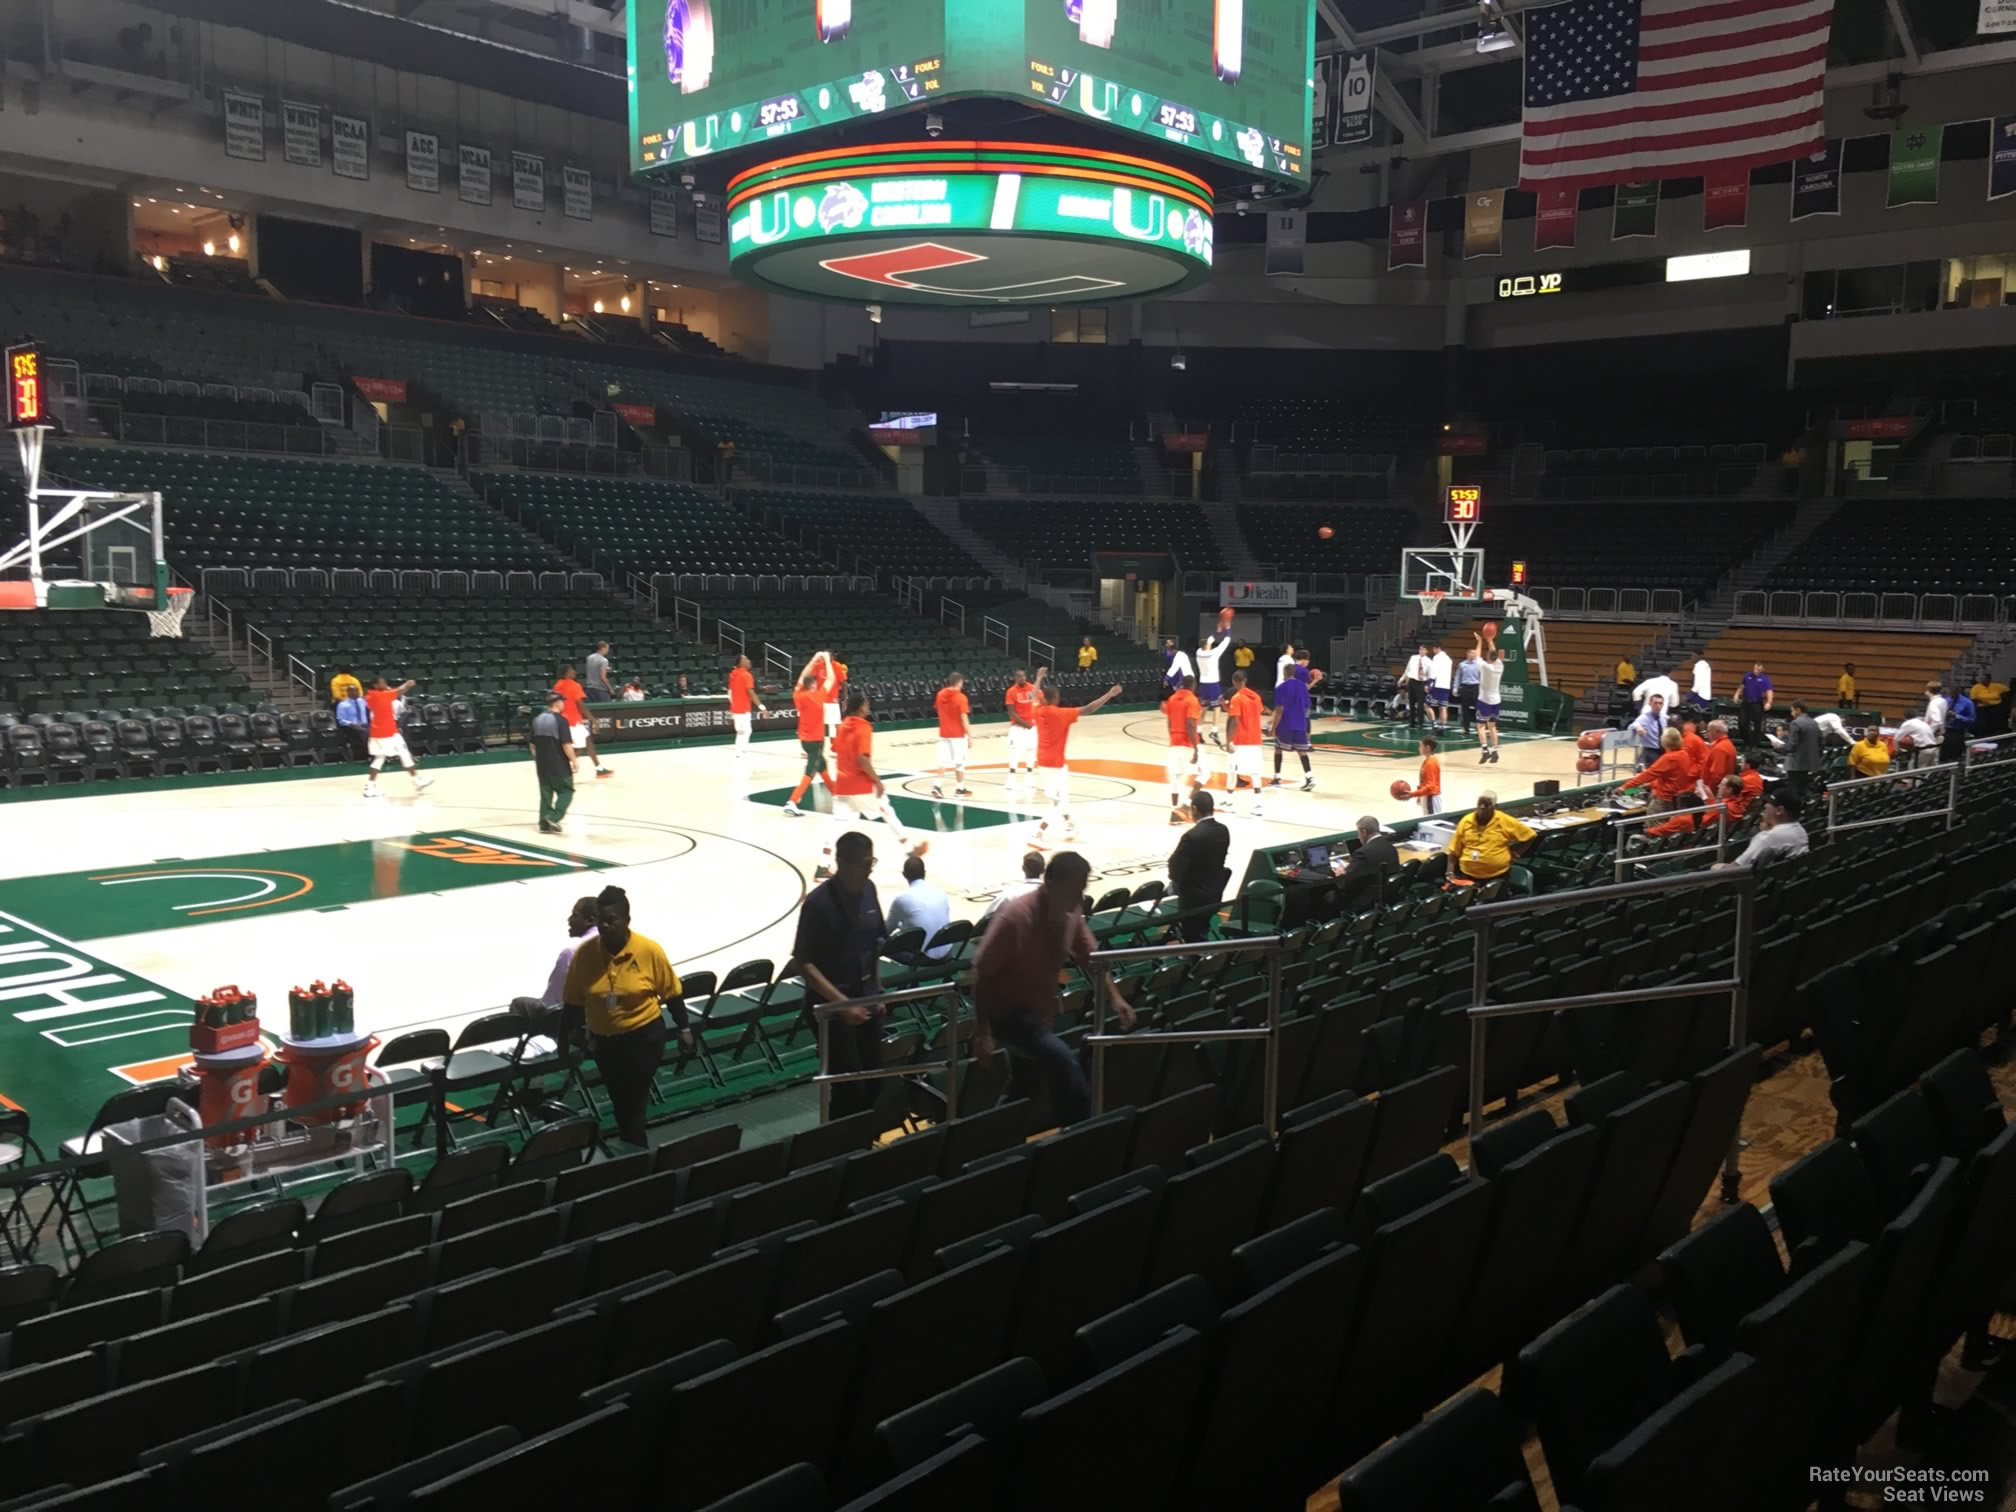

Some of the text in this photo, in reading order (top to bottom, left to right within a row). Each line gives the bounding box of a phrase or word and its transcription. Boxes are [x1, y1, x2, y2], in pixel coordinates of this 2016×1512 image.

[900, 59, 940, 79] 2 FOULS
[1031, 60, 1054, 77] FOULS
[909, 79, 940, 97] 4 TOL
[1031, 80, 1060, 100] TOL 4
[1348, 77, 1366, 97] 10
[818, 87, 830, 110] 0
[1131, 93, 1142, 116] 0
[760, 98, 799, 126] 57:53
[1160, 104, 1195, 133] 57:53
[334, 119, 366, 141] NCAA
[730, 111, 742, 133] 0
[1211, 120, 1223, 142] 0
[411, 136, 434, 155] ACC
[1273, 139, 1281, 152] 2
[461, 150, 489, 168] NCAA
[514, 158, 542, 176] NCAA
[1279, 159, 1287, 171] 4
[1799, 179, 1833, 192] CAROLINA
[1804, 173, 1829, 183] NORTH
[1539, 272, 1563, 290] yp
[1450, 488, 1479, 501] 57:53
[1453, 500, 1474, 519] 30
[331, 1063, 353, 1088] G
[230, 1078, 253, 1104] G
